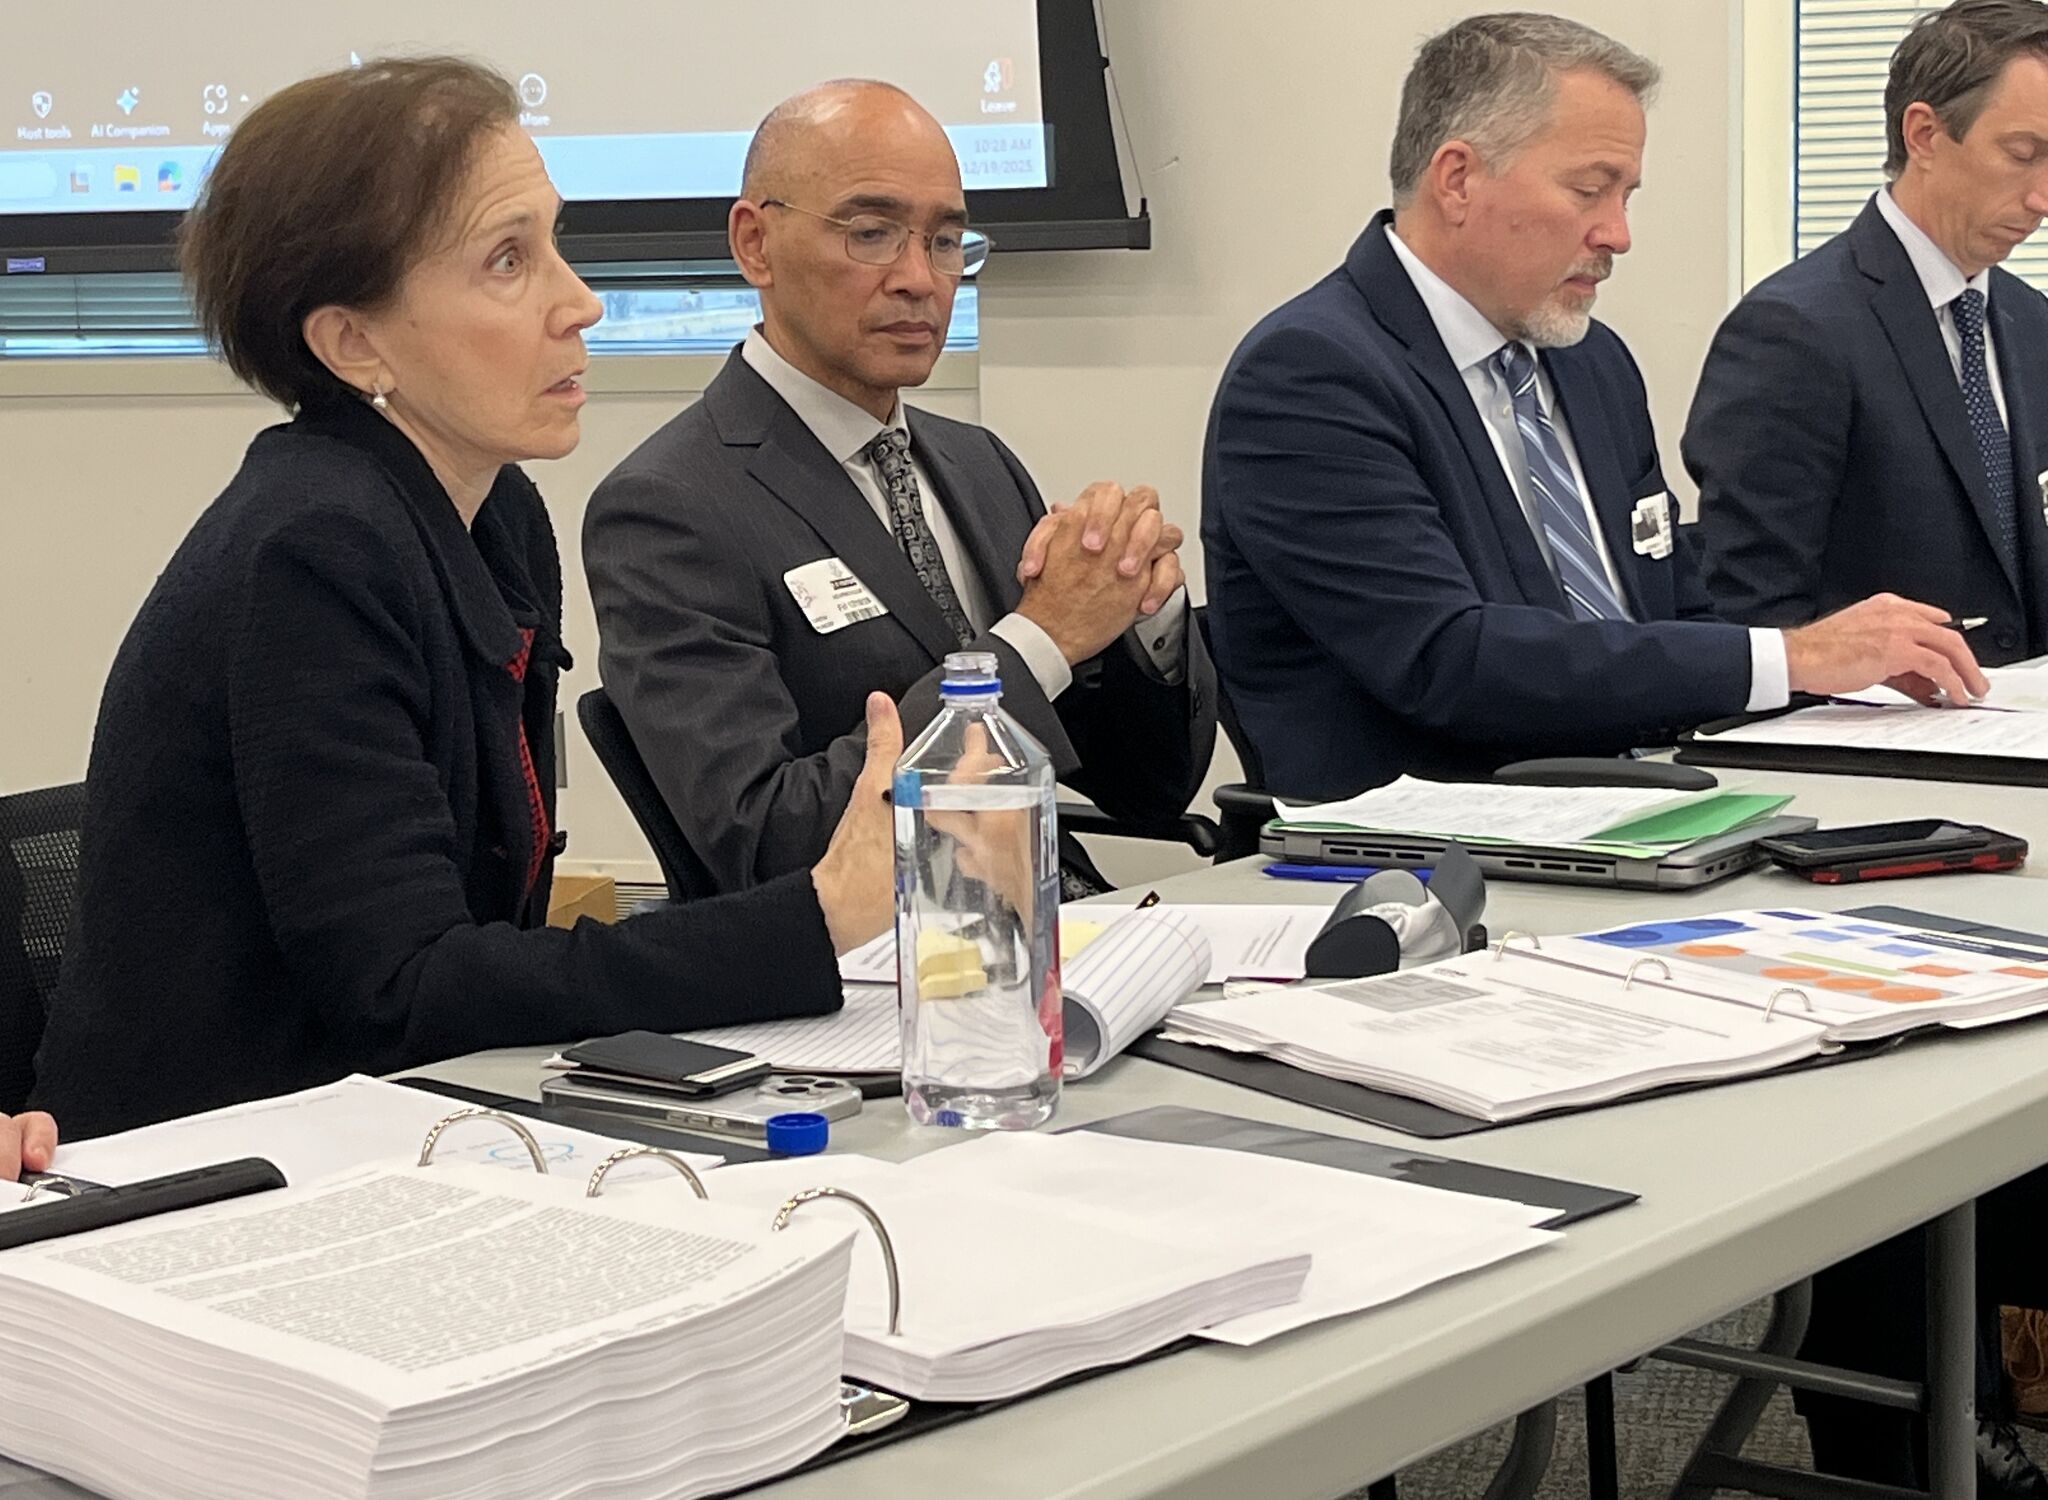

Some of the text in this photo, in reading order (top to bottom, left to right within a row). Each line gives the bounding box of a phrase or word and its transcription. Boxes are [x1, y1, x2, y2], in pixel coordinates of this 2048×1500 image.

[980, 99, 1017, 114] Leave
[17, 125, 72, 140] Host tools
[91, 123, 170, 140] AI Companion
[1010, 138, 1032, 150] AM
